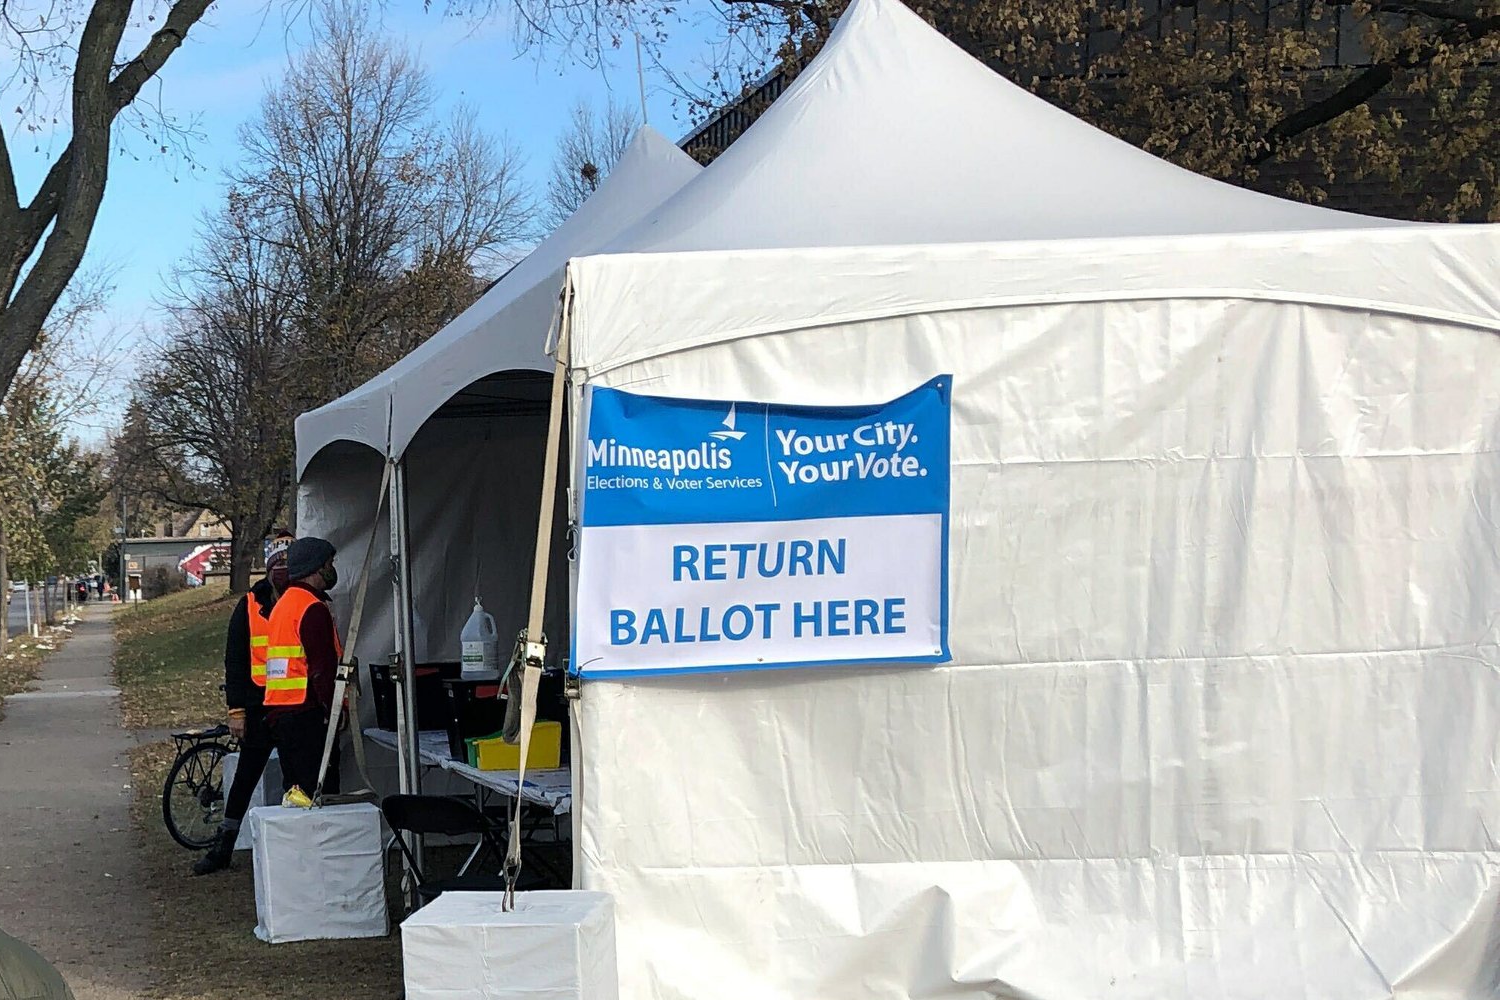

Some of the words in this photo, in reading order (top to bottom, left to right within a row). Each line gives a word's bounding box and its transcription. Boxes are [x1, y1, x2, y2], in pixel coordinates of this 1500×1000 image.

[777, 429, 849, 456] Your
[853, 420, 918, 451] City.
[588, 440, 732, 475] Minneapolis
[778, 459, 854, 485] Your
[855, 451, 927, 479] Vote.
[587, 475, 649, 490] Elections
[653, 478, 662, 490] &
[665, 477, 703, 490] Voter
[706, 476, 763, 490] Services
[672, 538, 846, 582] RETURN
[609, 604, 781, 646] BALLOT
[794, 597, 907, 638] HERE
